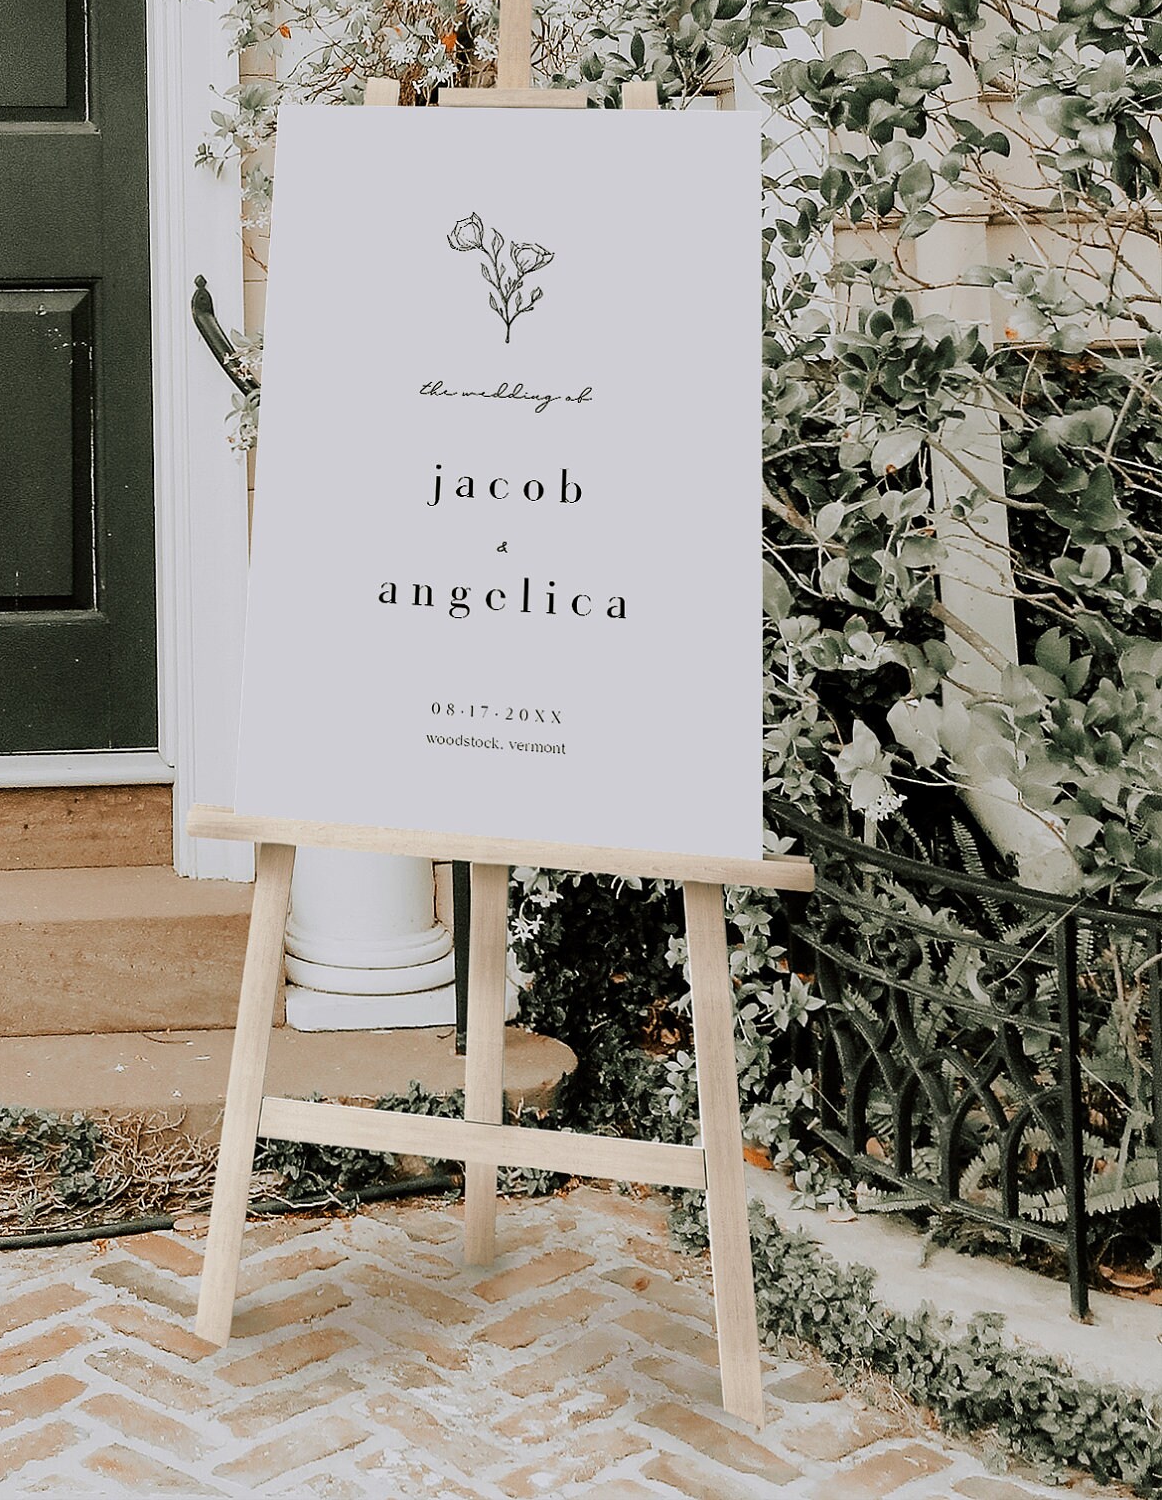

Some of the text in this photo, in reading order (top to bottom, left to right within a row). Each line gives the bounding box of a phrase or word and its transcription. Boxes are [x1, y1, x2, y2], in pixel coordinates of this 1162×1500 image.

[419, 380, 593, 414] the wedding of
[426, 463, 583, 507] jacob
[496, 540, 508, 554] &
[378, 577, 627, 620] angelica
[508, 739, 567, 755] vermont
